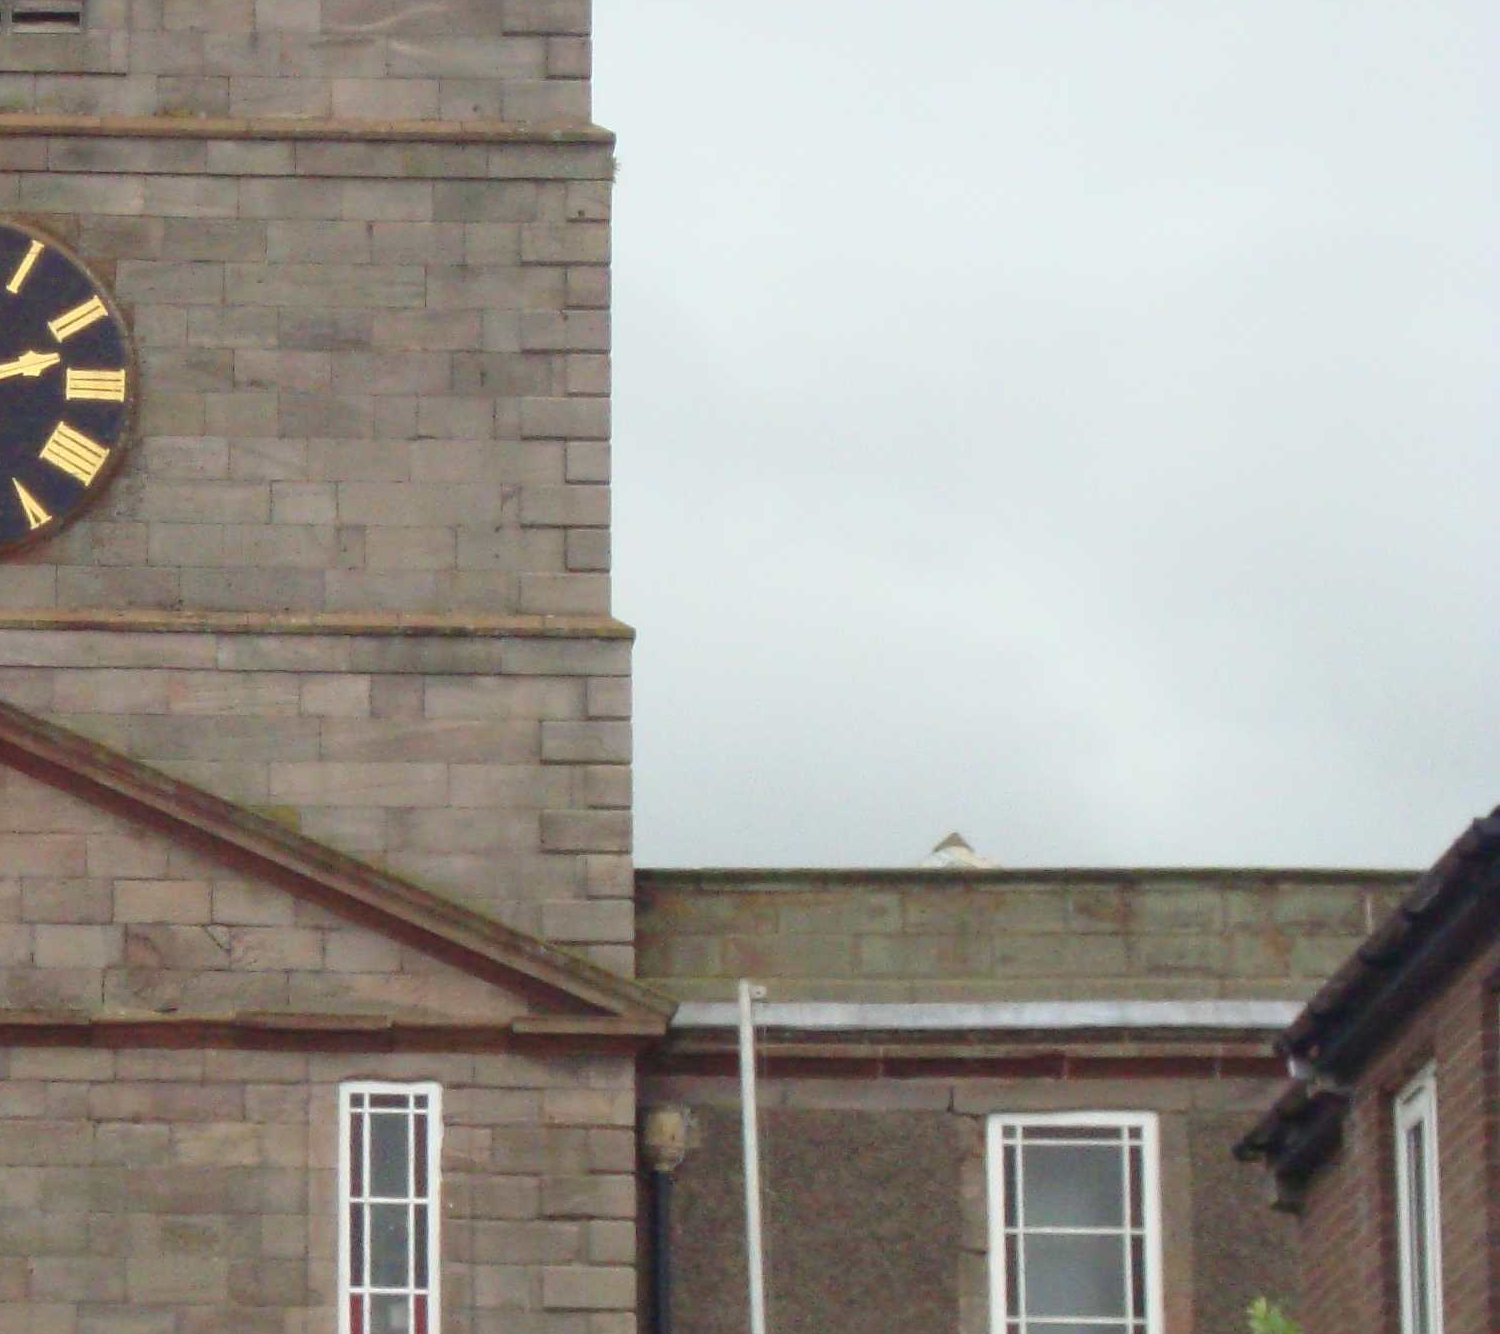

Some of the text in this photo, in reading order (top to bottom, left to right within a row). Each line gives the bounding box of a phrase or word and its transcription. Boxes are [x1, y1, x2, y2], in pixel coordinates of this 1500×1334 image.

[6, 238, 44, 294] I
[48, 294, 108, 343] II
[66, 367, 125, 402] III
[39, 421, 110, 487] IIII
[11, 477, 53, 530] V
